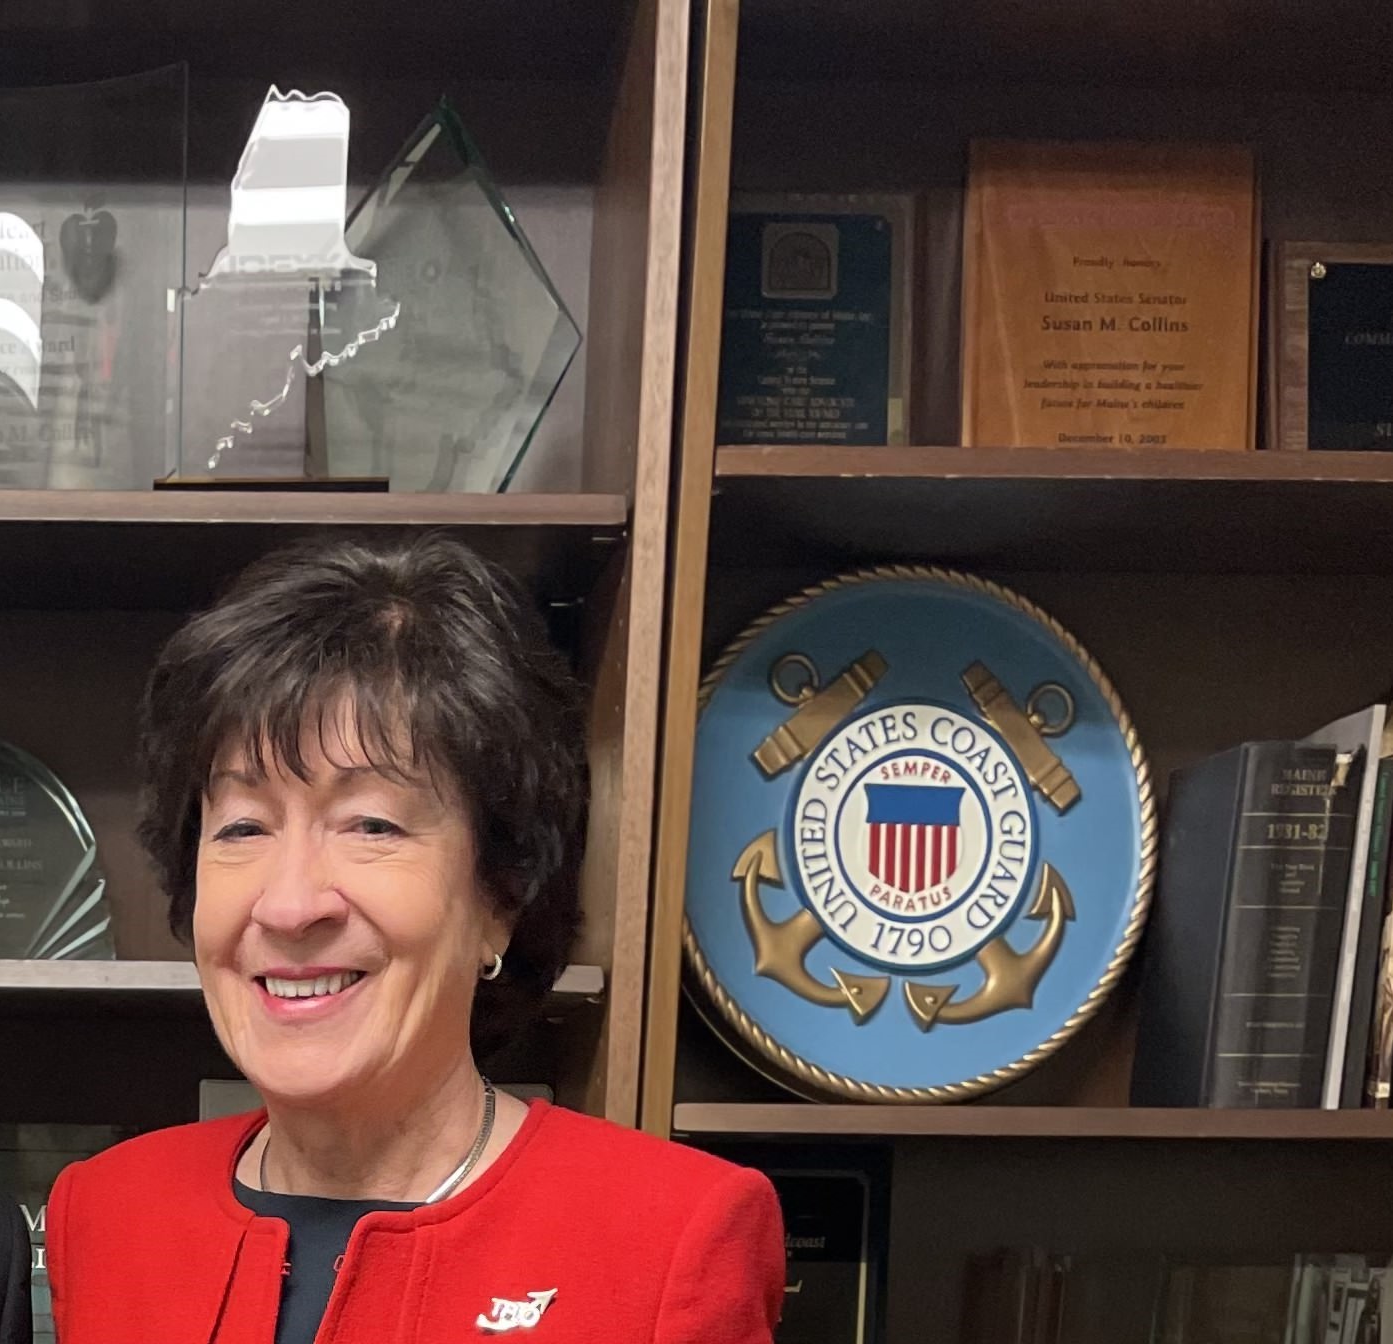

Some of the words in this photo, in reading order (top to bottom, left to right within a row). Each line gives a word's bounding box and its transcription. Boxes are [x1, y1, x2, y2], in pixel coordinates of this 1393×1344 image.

[1044, 291, 1088, 304] United
[1094, 292, 1133, 304] States
[1138, 292, 1187, 306] Senator
[1041, 315, 1093, 332] Susan
[1128, 315, 1190, 333] Collins
[1058, 432, 1114, 444] December
[814, 711, 919, 790] STATES
[930, 714, 1019, 801] COAST
[880, 760, 953, 786] SEMPER
[1282, 768, 1327, 781] MAINE
[1270, 783, 1337, 797] REGISTER
[801, 797, 859, 934] UNITED
[965, 809, 1028, 931] GUARD
[868, 884, 953, 913] PARATUS
[870, 921, 953, 959] 1790
